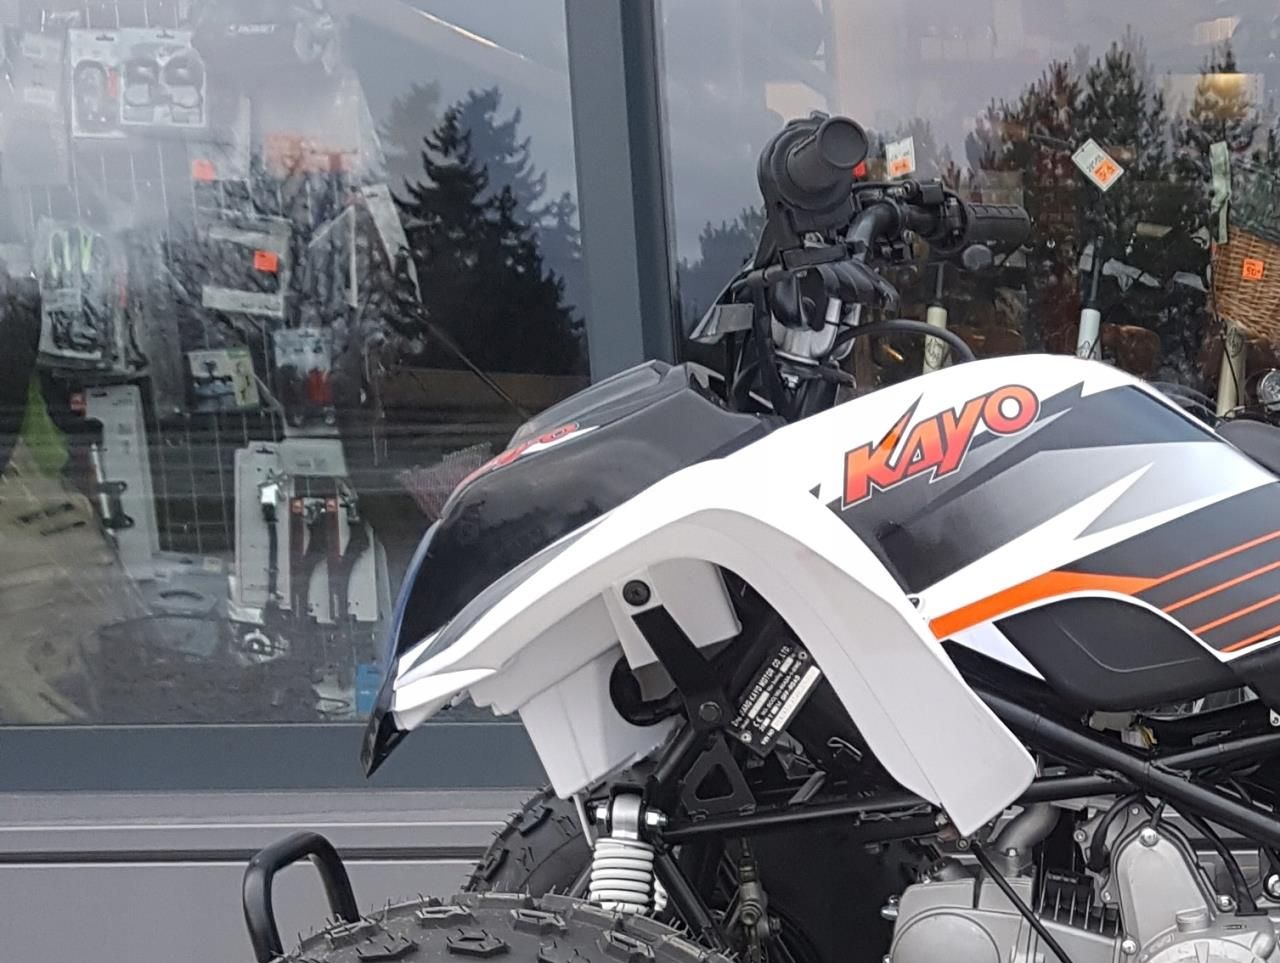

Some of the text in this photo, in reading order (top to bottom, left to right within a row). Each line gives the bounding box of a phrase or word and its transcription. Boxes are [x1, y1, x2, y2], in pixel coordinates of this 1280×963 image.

[842, 384, 1039, 510] KAYO
[748, 684, 763, 701] KAYO
[758, 667, 775, 687] MOTOR
